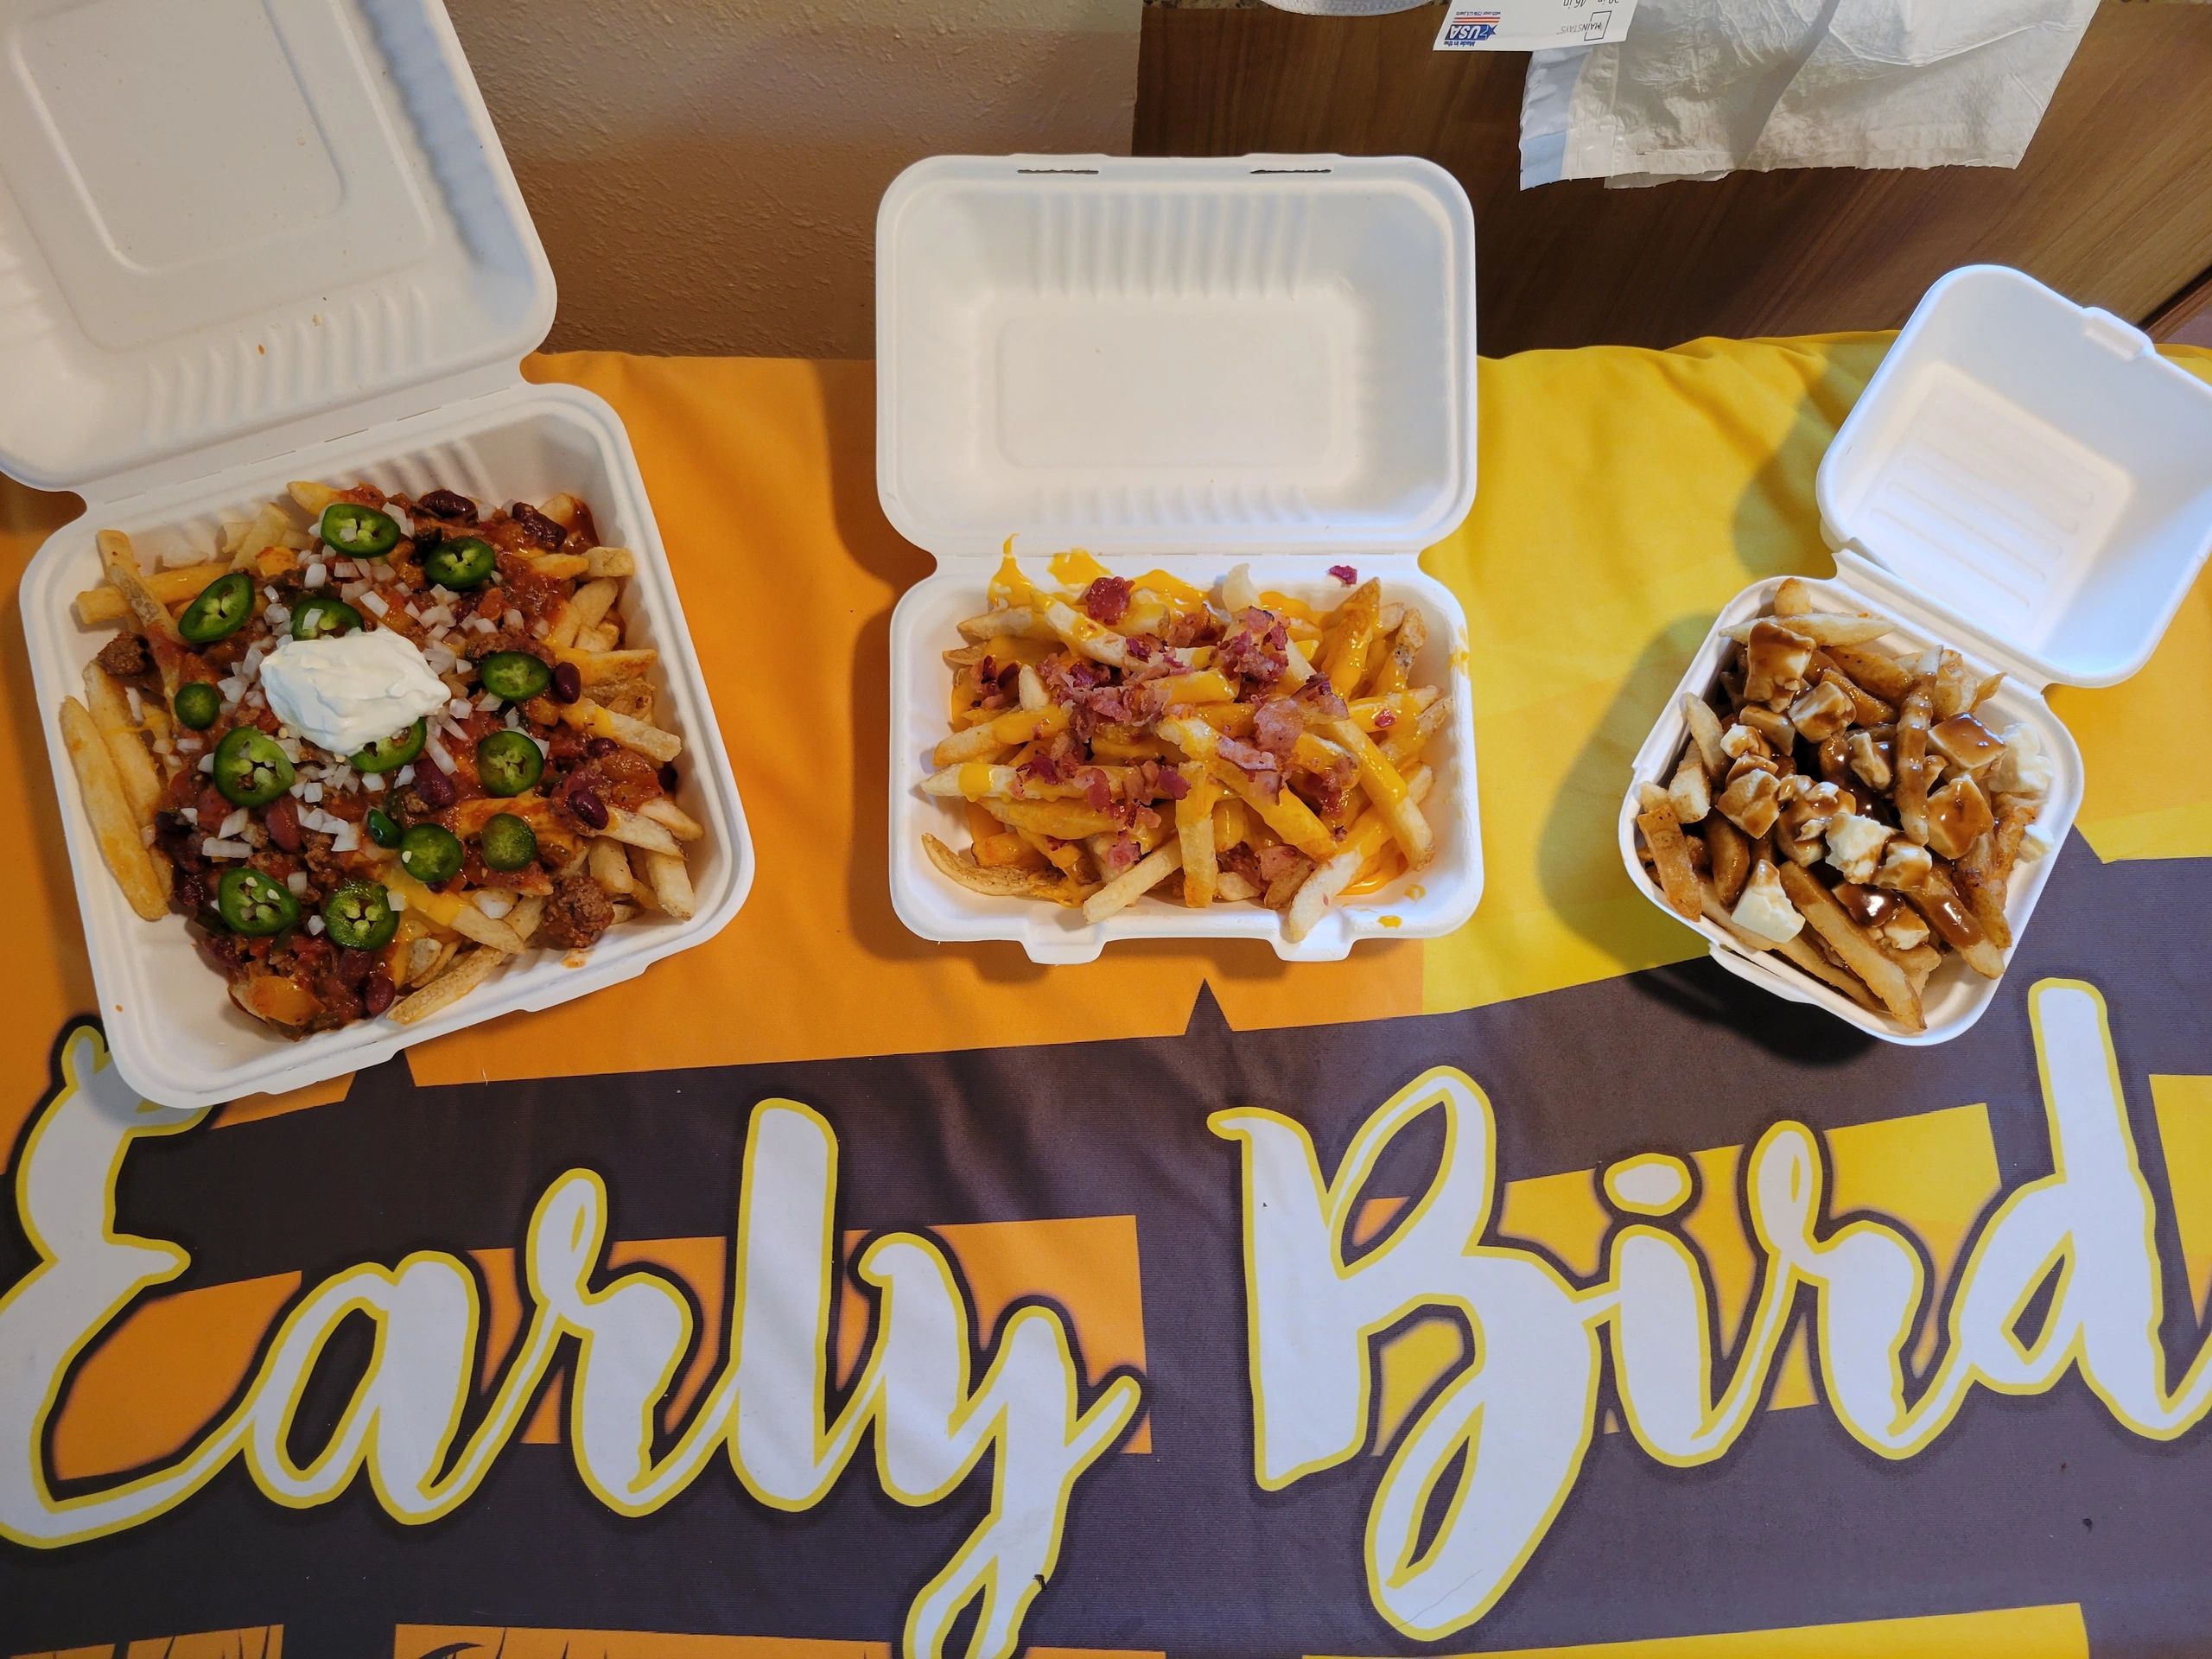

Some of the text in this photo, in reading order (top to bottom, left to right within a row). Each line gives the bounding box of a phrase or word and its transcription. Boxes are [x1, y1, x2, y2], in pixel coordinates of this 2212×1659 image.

[1449, 25, 1481, 40] USA
[1560, 22, 1603, 33] MAINSTAYS
[0, 977, 2212, 1659] Early Bird
